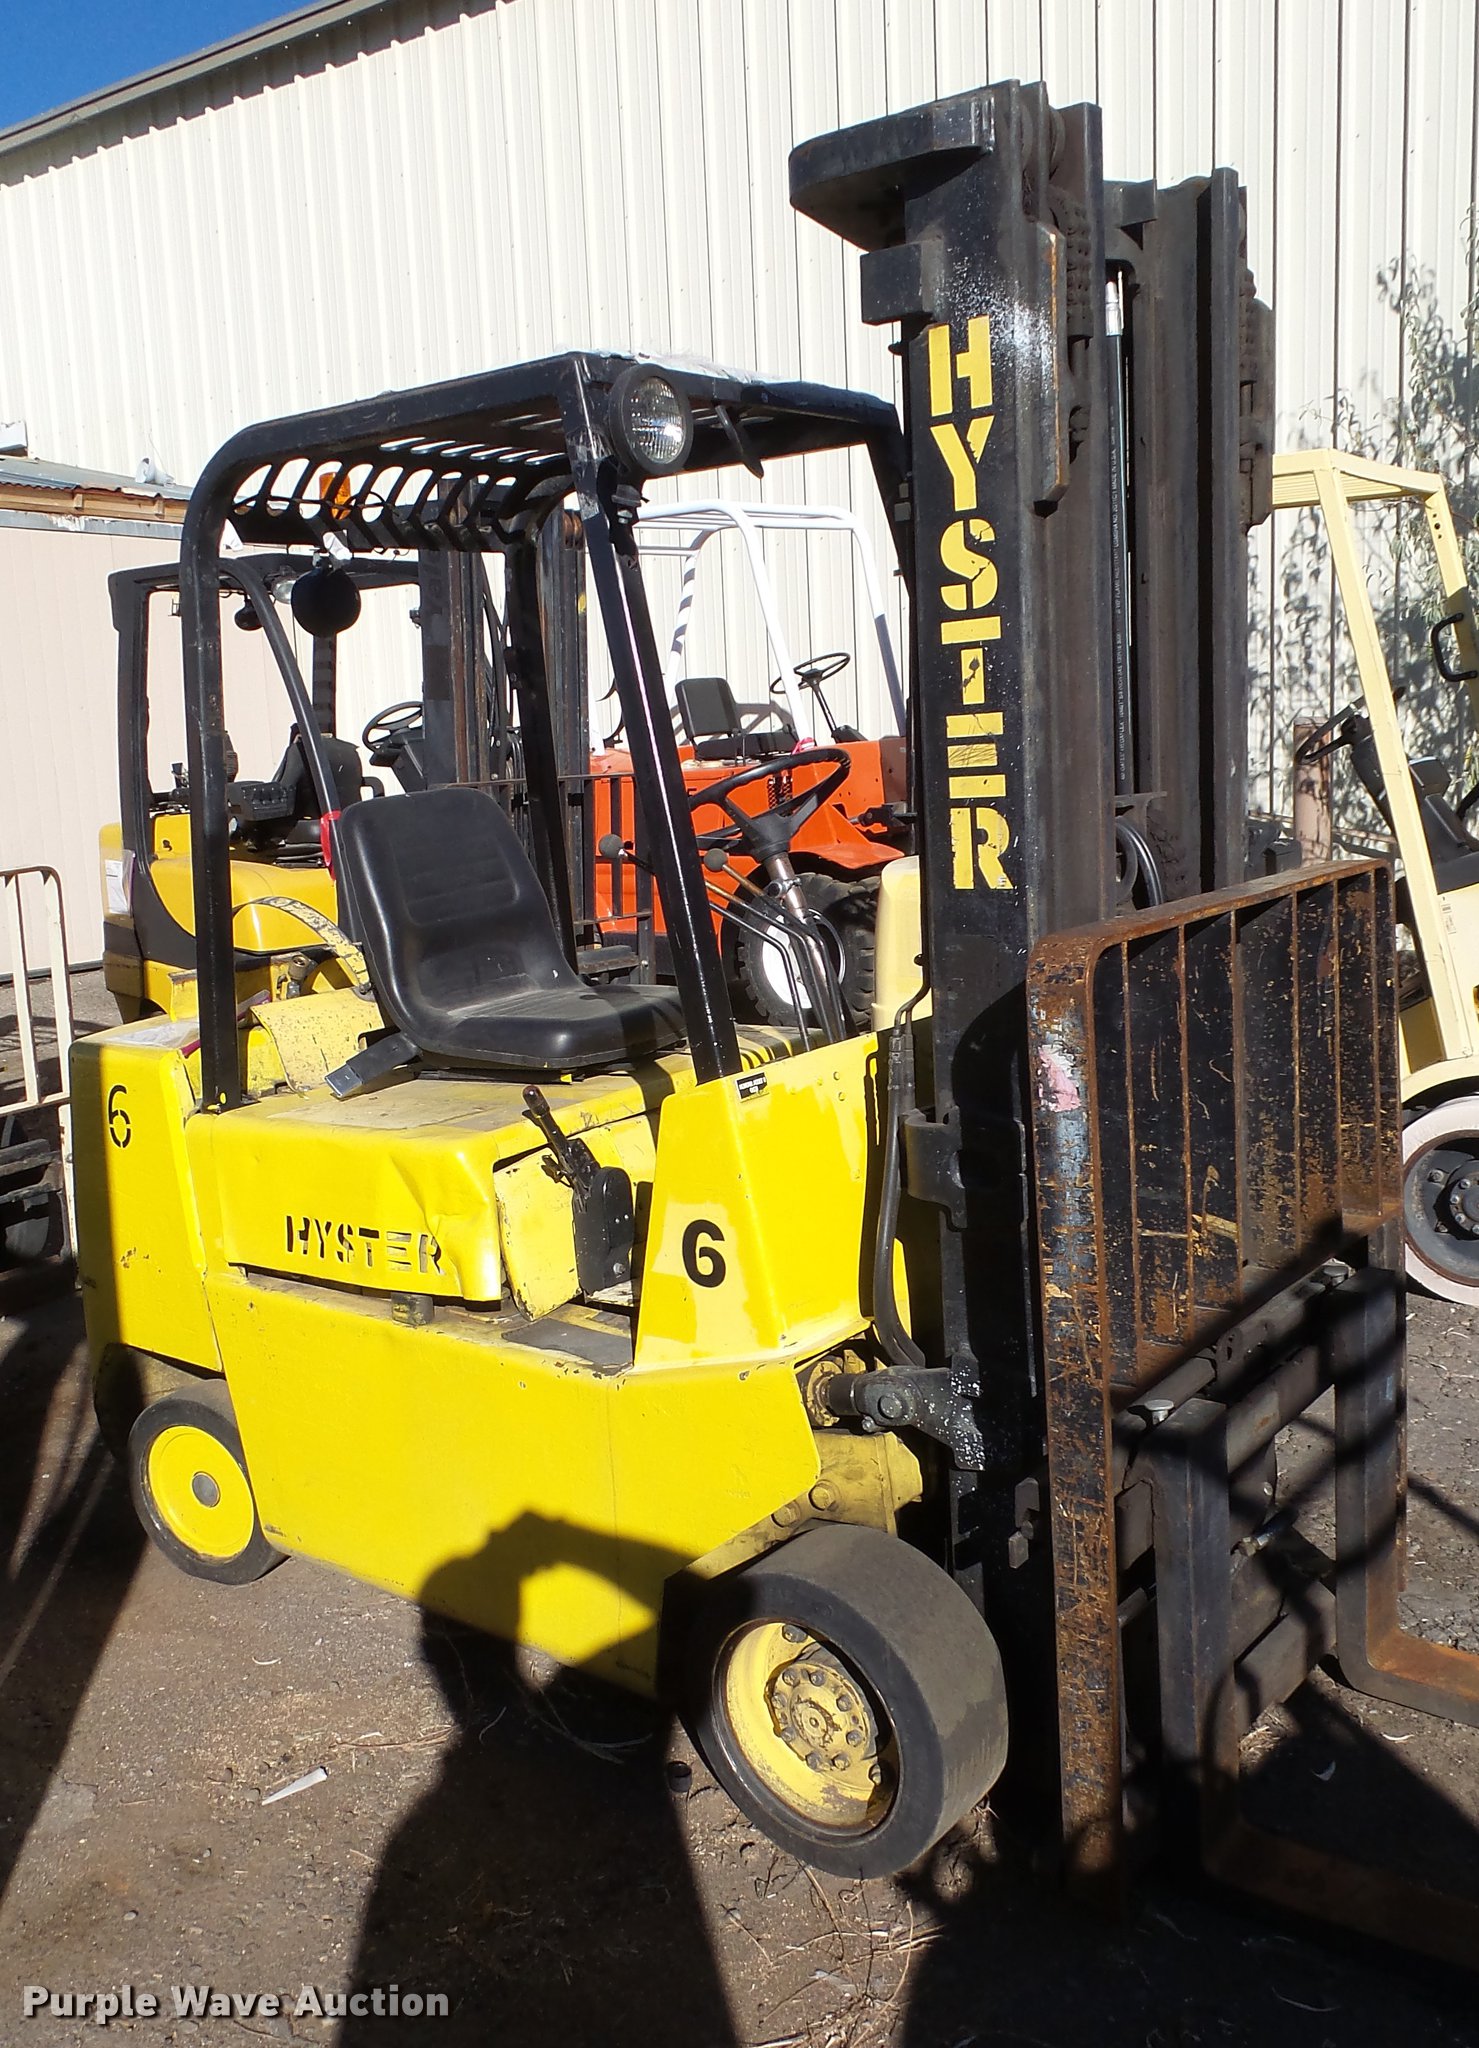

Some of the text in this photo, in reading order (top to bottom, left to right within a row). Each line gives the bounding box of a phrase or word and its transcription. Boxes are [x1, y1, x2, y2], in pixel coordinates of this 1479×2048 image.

[928, 315, 1014, 889] HYSTER
[108, 1084, 131, 1148] 6
[286, 1215, 446, 1275] HYSTER
[682, 1219, 726, 1288] 6
